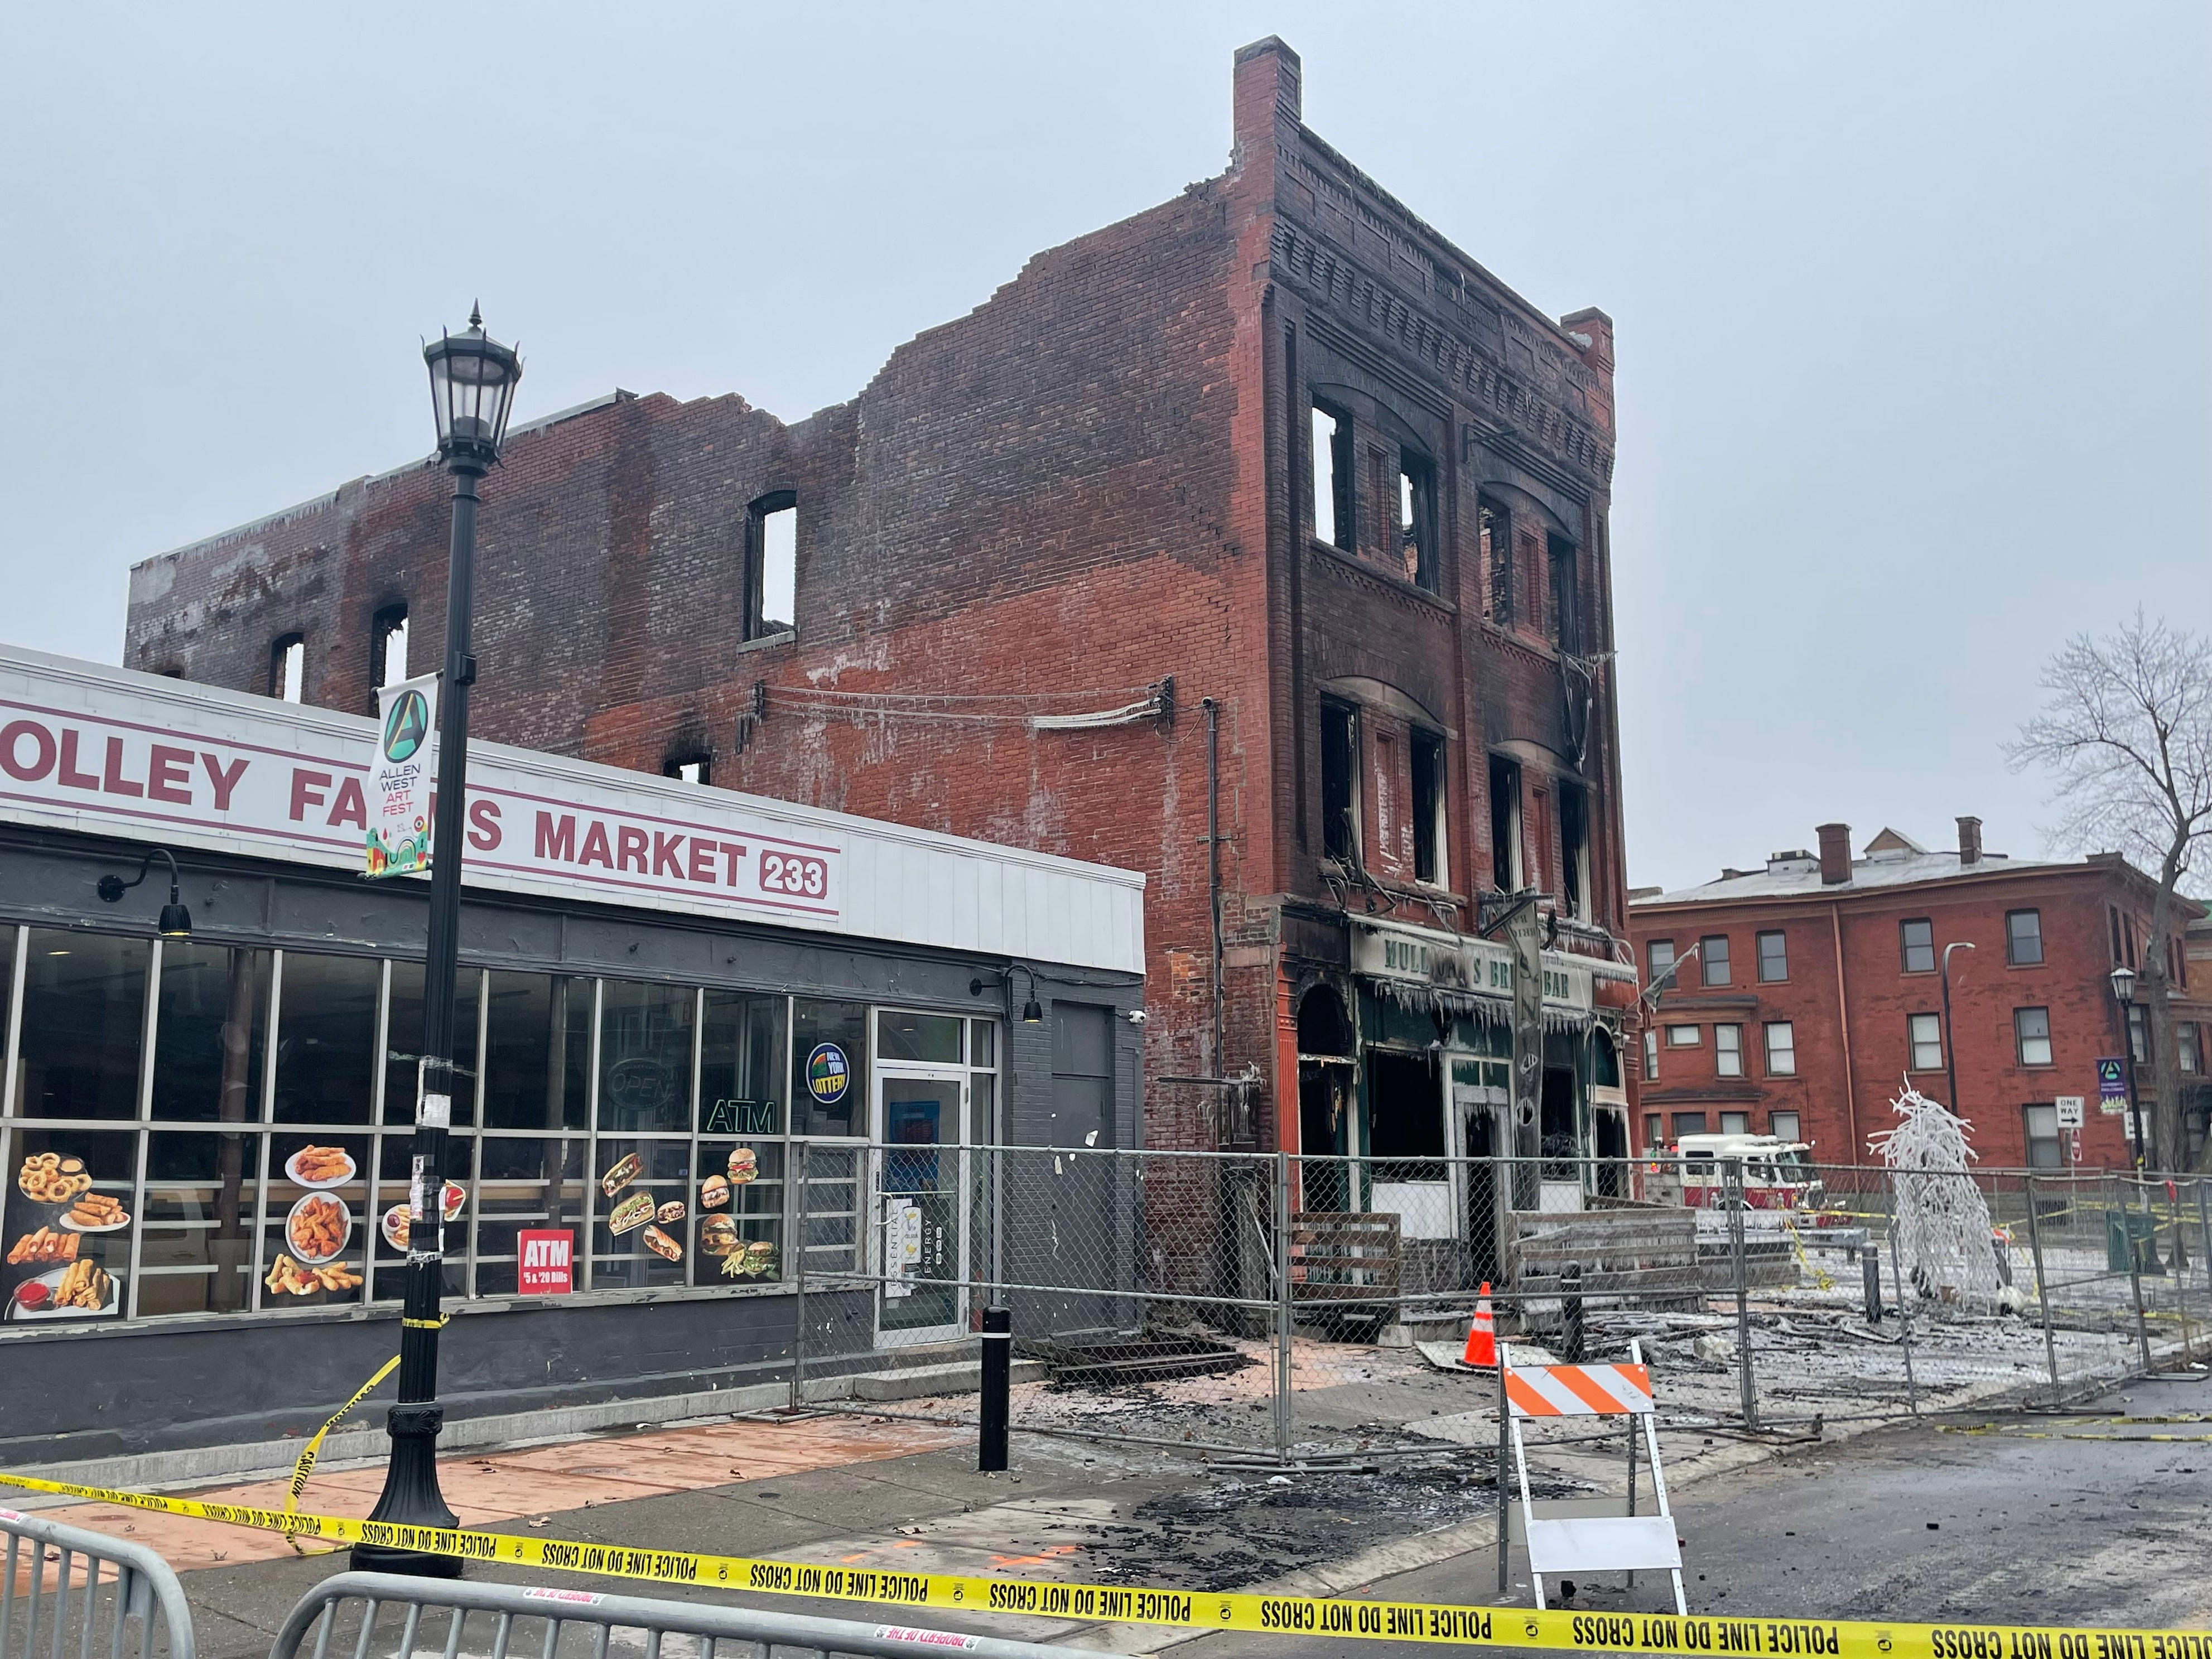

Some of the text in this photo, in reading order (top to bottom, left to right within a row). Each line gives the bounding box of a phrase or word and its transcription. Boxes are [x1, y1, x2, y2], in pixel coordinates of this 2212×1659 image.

[379, 764, 421, 781] ALLEN
[381, 777, 417, 792] WEST
[0, 720, 823, 895] OLLEY FAS MARKET 233
[383, 802, 414, 817] FEST
[385, 789, 411, 804] ART
[1544, 970, 1569, 999] BAR
[826, 1052, 841, 1061] NEW
[827, 1061, 845, 1075] YORK
[611, 1072, 670, 1100] OPEN
[812, 1073, 846, 1094] LOTTERY
[706, 1098, 775, 1133] ATM
[523, 1240, 569, 1267] ATM
[924, 1219, 932, 1274] ENERGY
[531, 1273, 538, 1284] &
[551, 1271, 568, 1283] Bills
[291, 1451, 315, 1499] CAUTION
[202, 1504, 321, 1535] POLICE LINE DO NOT CROSS
[360, 1523, 496, 1557] POLICE LINE DO NOT CROSS
[542, 1544, 698, 1580] POLICE LINE DO NOT CROSS
[750, 1564, 928, 1602] POLICE LINE DO NOT CROSS
[990, 1583, 1191, 1622] POLICE LINE DO NOT CROSS
[1261, 1600, 1492, 1639] POLICE LINE DO NOT CROSS
[886, 1628, 967, 1647] PROPERTY OF THE
[1573, 1616, 1839, 1655] POLICE LINE DO NOT CROSS
[1932, 1630, 2002, 1659] CROSS
[2011, 1632, 2052, 1659] NOT
[2060, 1633, 2089, 1659] DO
[2095, 1634, 2146, 1659] LINE
